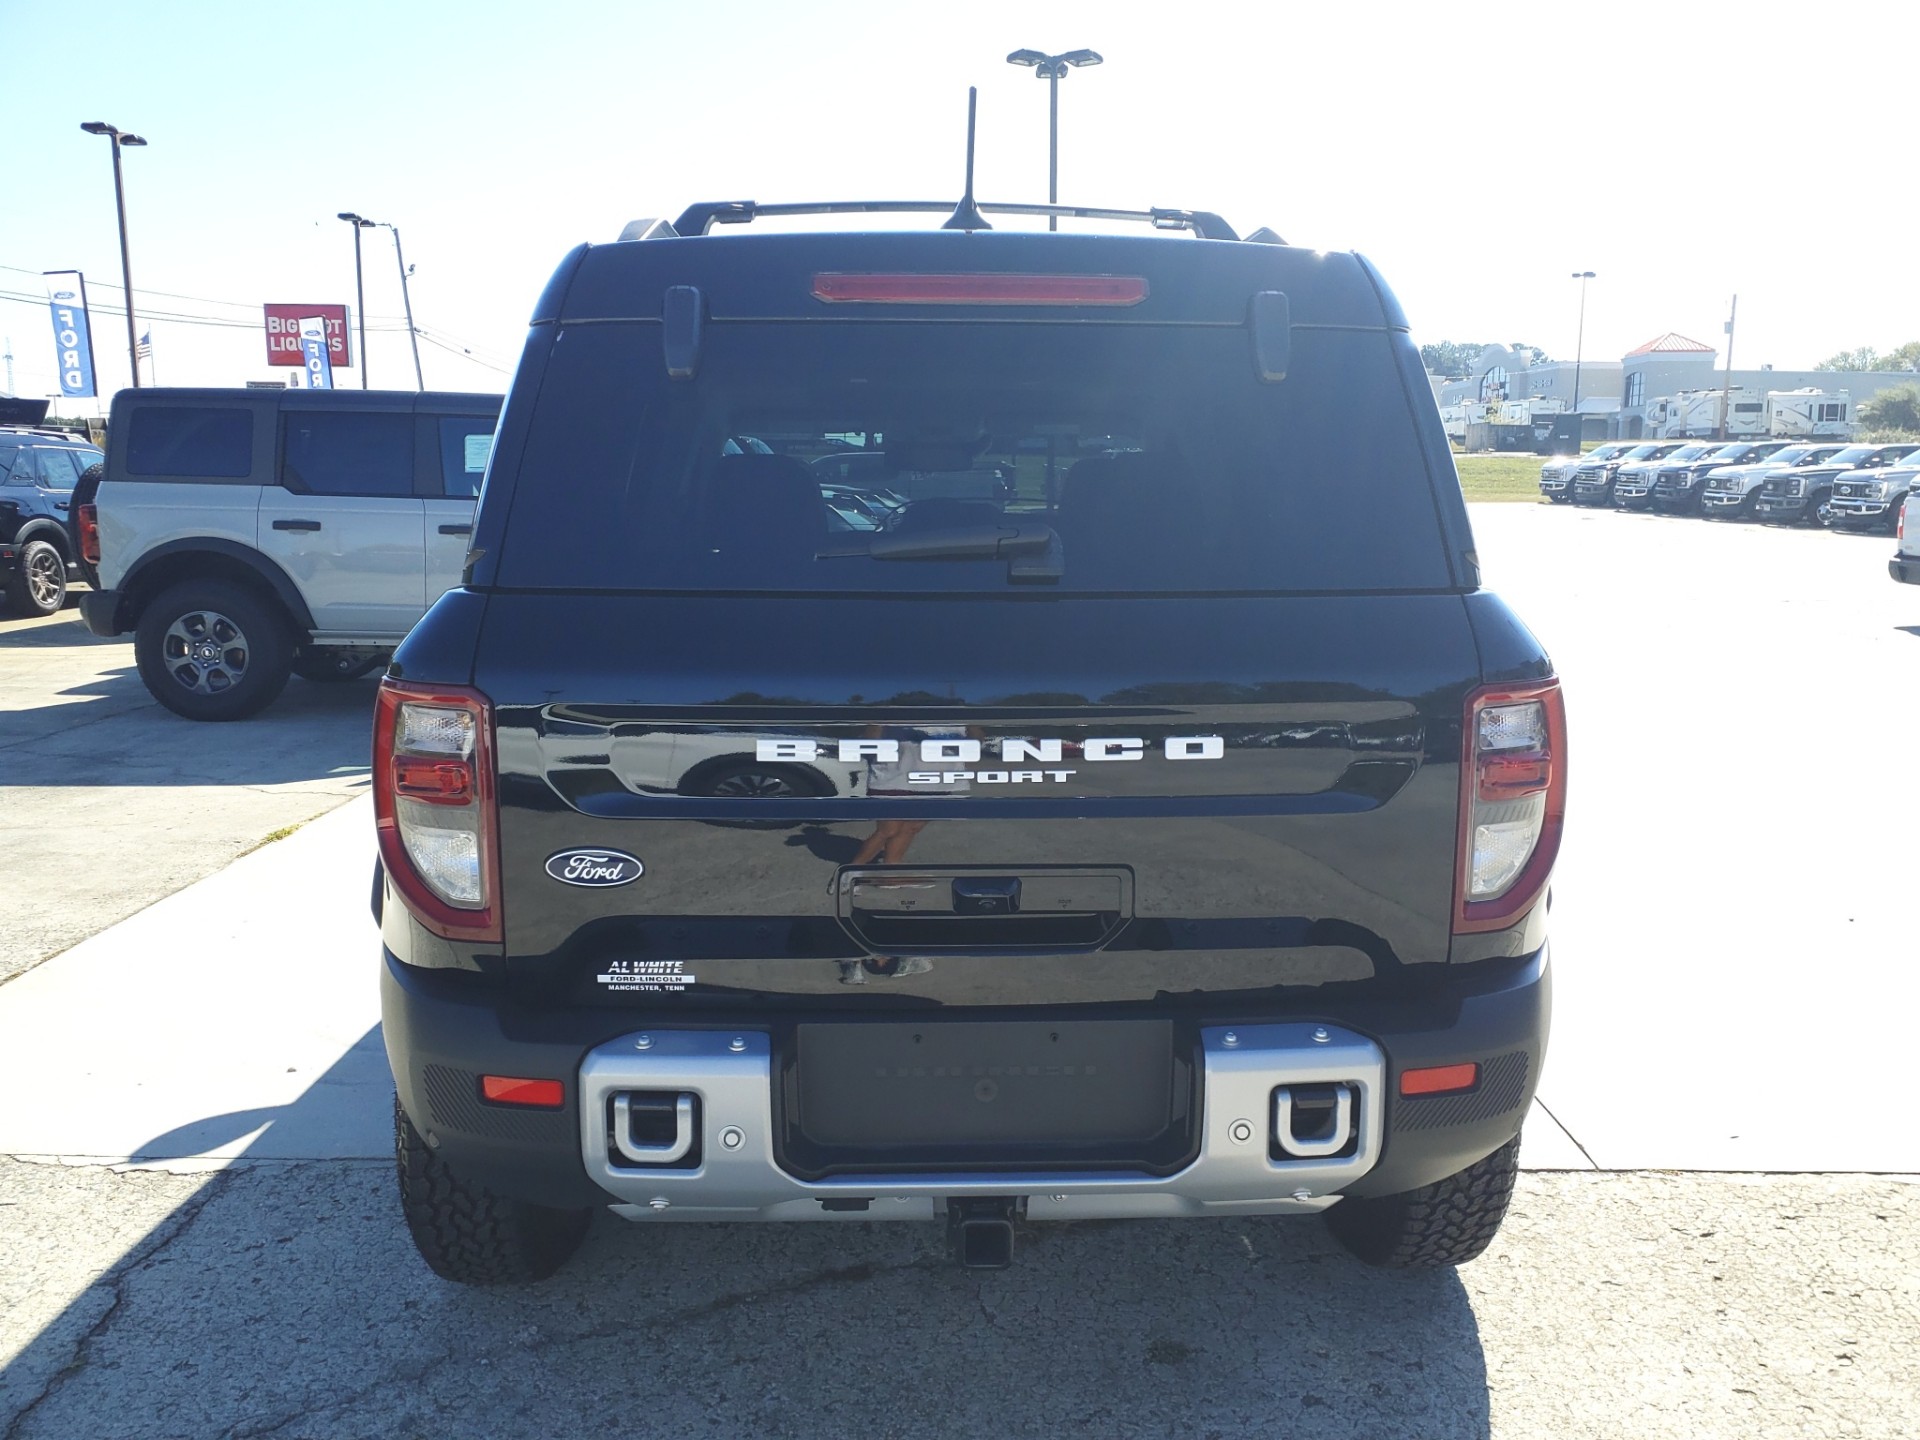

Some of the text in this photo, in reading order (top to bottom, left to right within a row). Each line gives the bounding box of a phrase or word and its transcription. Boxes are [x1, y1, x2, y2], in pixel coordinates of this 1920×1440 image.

[267, 316, 343, 334] BIGOT
[270, 336, 343, 352] LIQUS
[755, 736, 1225, 763] BRONCO
[907, 770, 1077, 784] SPORT
[564, 855, 624, 881] Ford
[608, 961, 684, 974] AL WHITE
